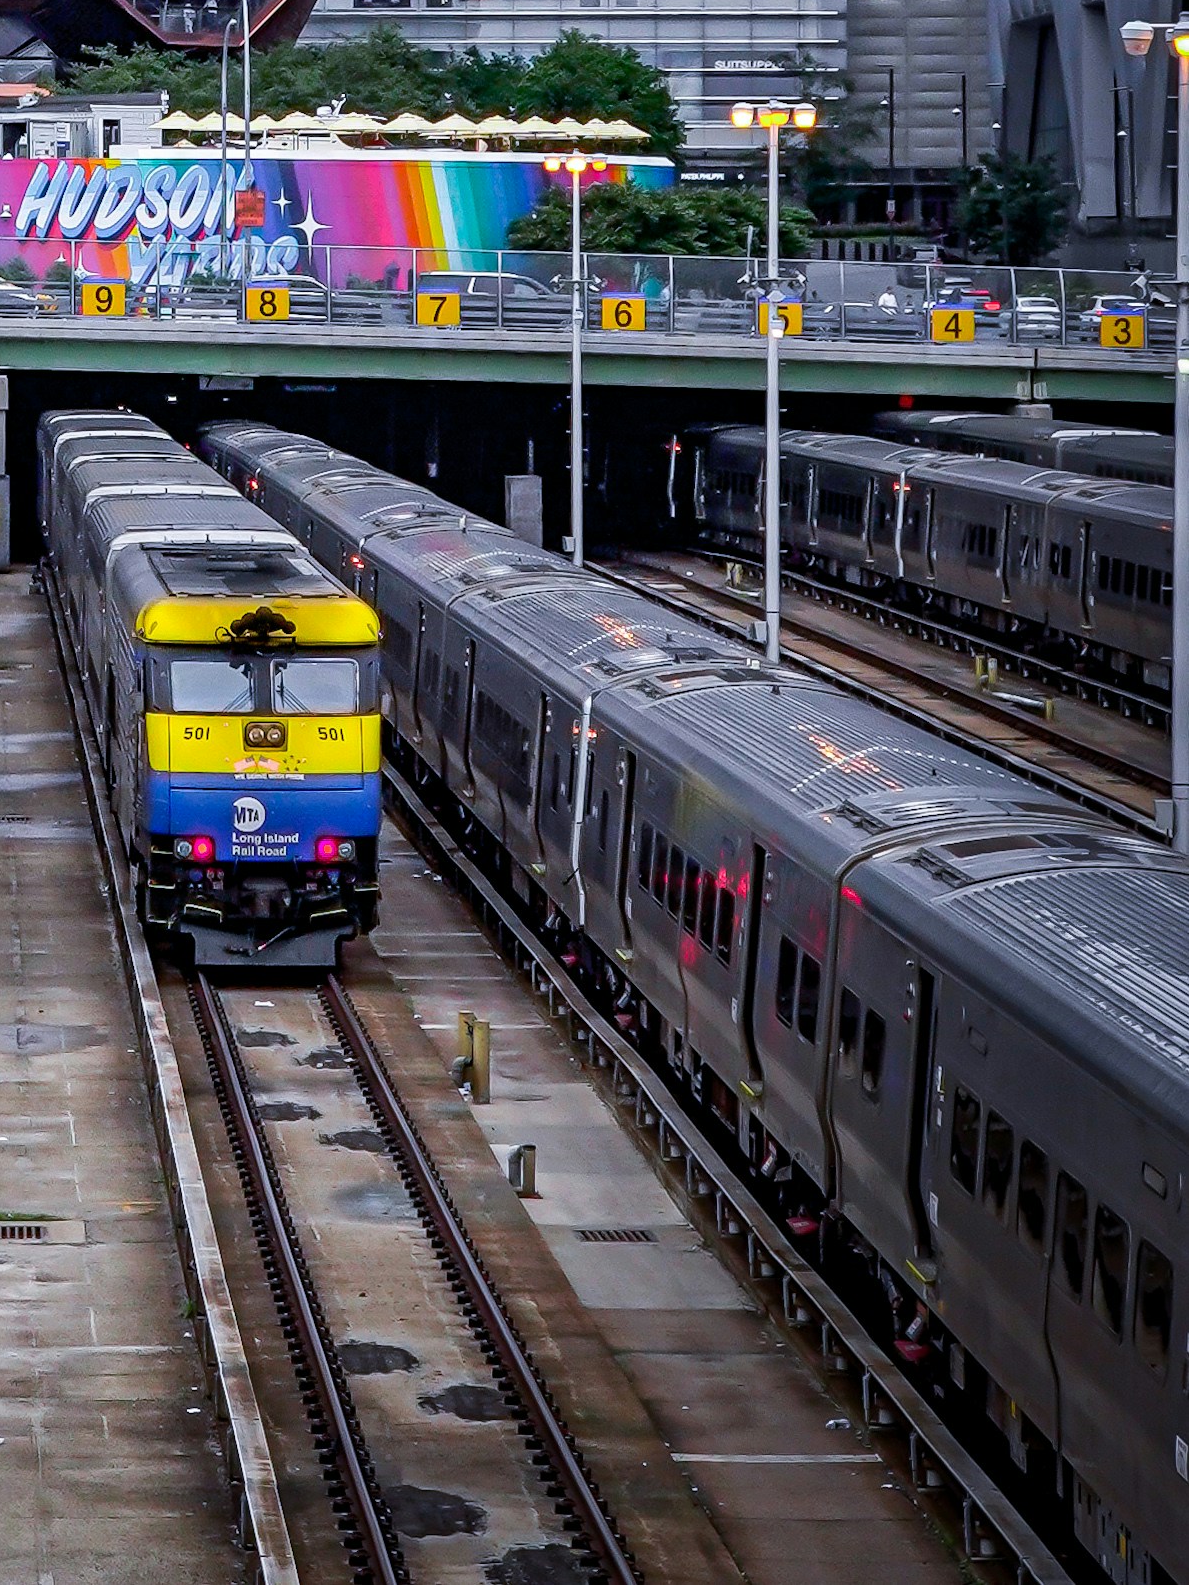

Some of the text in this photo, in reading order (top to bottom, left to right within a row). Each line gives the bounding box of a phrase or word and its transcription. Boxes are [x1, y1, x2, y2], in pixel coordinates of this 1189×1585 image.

[15, 161, 255, 240] HUDSON
[95, 286, 113, 312] 9
[259, 291, 277, 316] 8
[429, 296, 447, 322] 7
[614, 301, 632, 327] 6
[944, 313, 962, 339] 4
[1113, 319, 1131, 345] 3
[183, 727, 210, 740] 501
[318, 727, 345, 741] 501
[234, 805, 260, 824] MTA
[232, 833, 299, 845] Long Island
[232, 846, 287, 856] Rail Road
